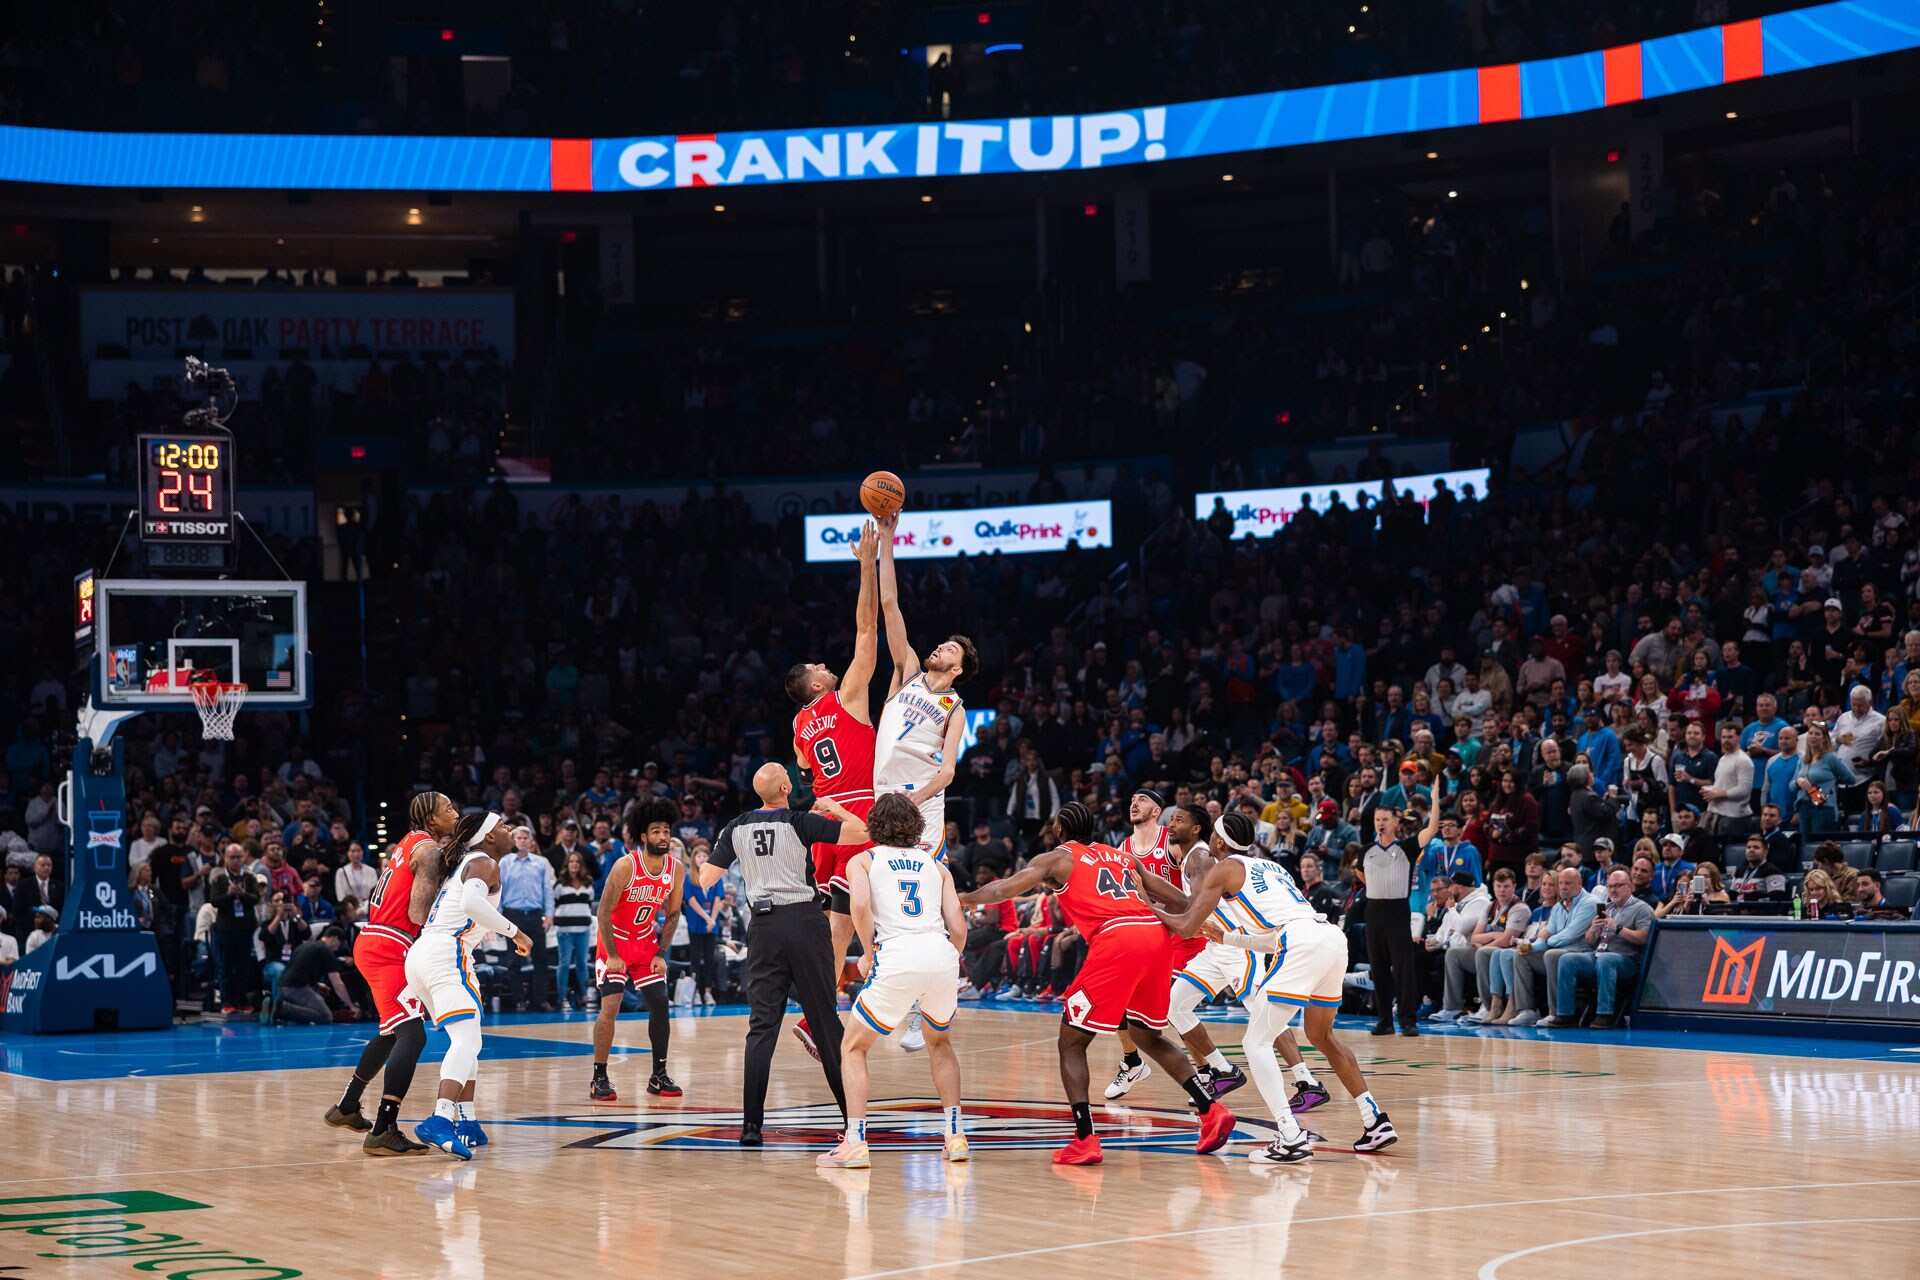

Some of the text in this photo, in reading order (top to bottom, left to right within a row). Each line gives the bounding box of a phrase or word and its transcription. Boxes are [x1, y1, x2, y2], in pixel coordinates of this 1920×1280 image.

[619, 129, 898, 188] CRANK
[125, 316, 485, 346] POST OAK PARTY TERRACE
[159, 443, 219, 470] 12:00
[158, 470, 213, 513] 24
[877, 480, 903, 498] Wilson
[169, 521, 228, 535] TISSOT
[974, 519, 1062, 540] QuikPrint
[899, 692, 945, 727] OKLAHOMA
[903, 707, 927, 726] CITY
[897, 720, 915, 741] 7
[813, 737, 843, 778] 9
[92, 834, 118, 844] SONIC
[753, 829, 776, 857] 37
[888, 858, 924, 873] GIDDEY
[95, 881, 117, 908] OU
[897, 879, 923, 918] 3
[79, 908, 136, 929] Health
[633, 905, 654, 926] 0
